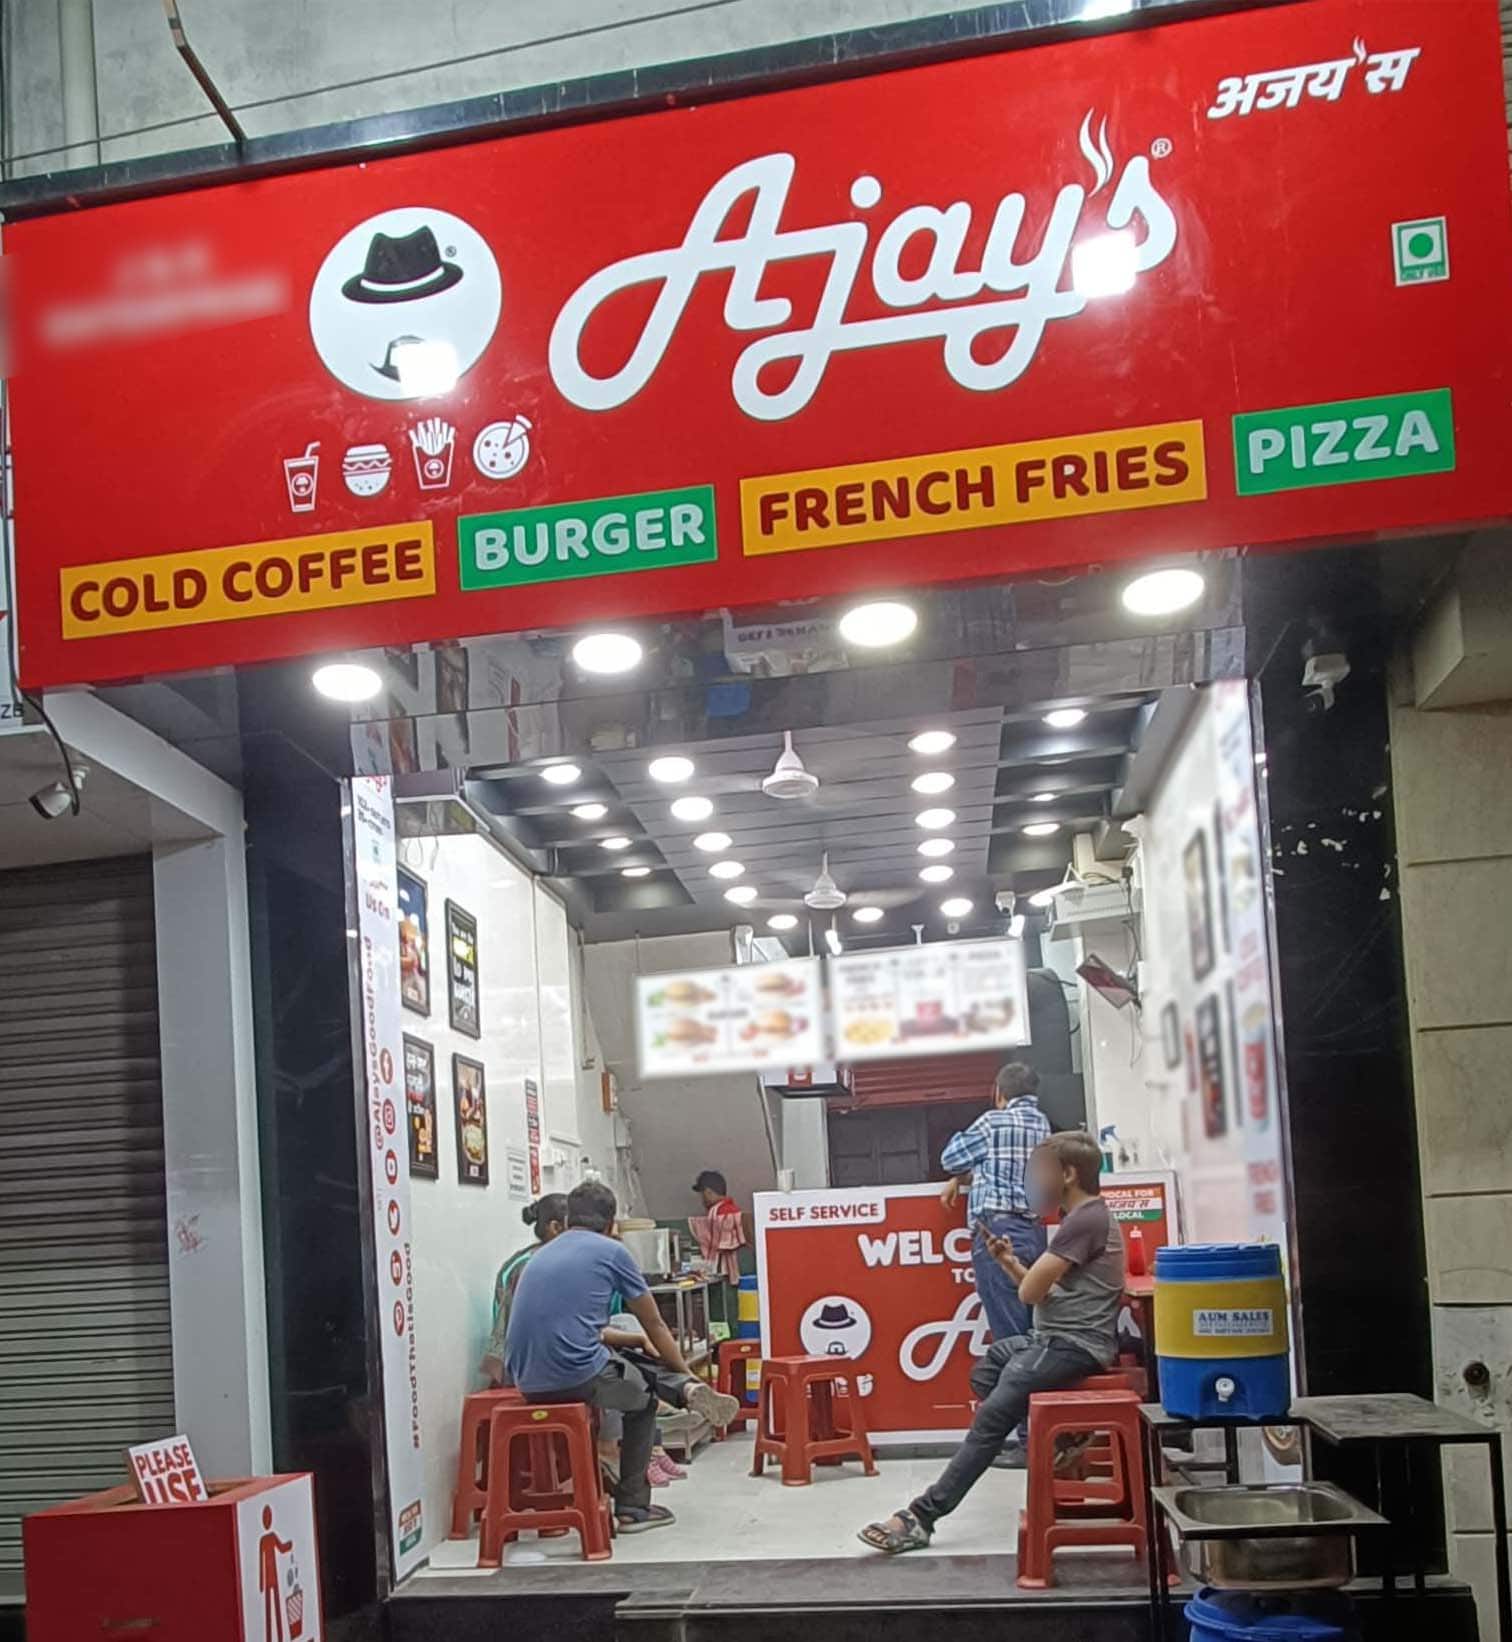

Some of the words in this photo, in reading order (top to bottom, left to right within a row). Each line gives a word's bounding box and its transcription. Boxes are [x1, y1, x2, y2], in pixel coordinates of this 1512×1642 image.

[549, 107, 1178, 420] Ajay's
[1248, 410, 1440, 474] PIZZA
[761, 467, 993, 536] FRENCH
[1015, 441, 1189, 504] FRIES
[474, 503, 706, 572] BURGER
[70, 570, 207, 622] COLD
[223, 540, 425, 600] COFFEE
[769, 1207, 806, 1221] SELF
[810, 1203, 879, 1219] SERVICE
[857, 1228, 973, 1267] WELC
[1199, 1311, 1227, 1322] AUM
[1232, 1310, 1269, 1322] SALES
[134, 1442, 193, 1479] PLEASE
[144, 1468, 202, 1503] USE
